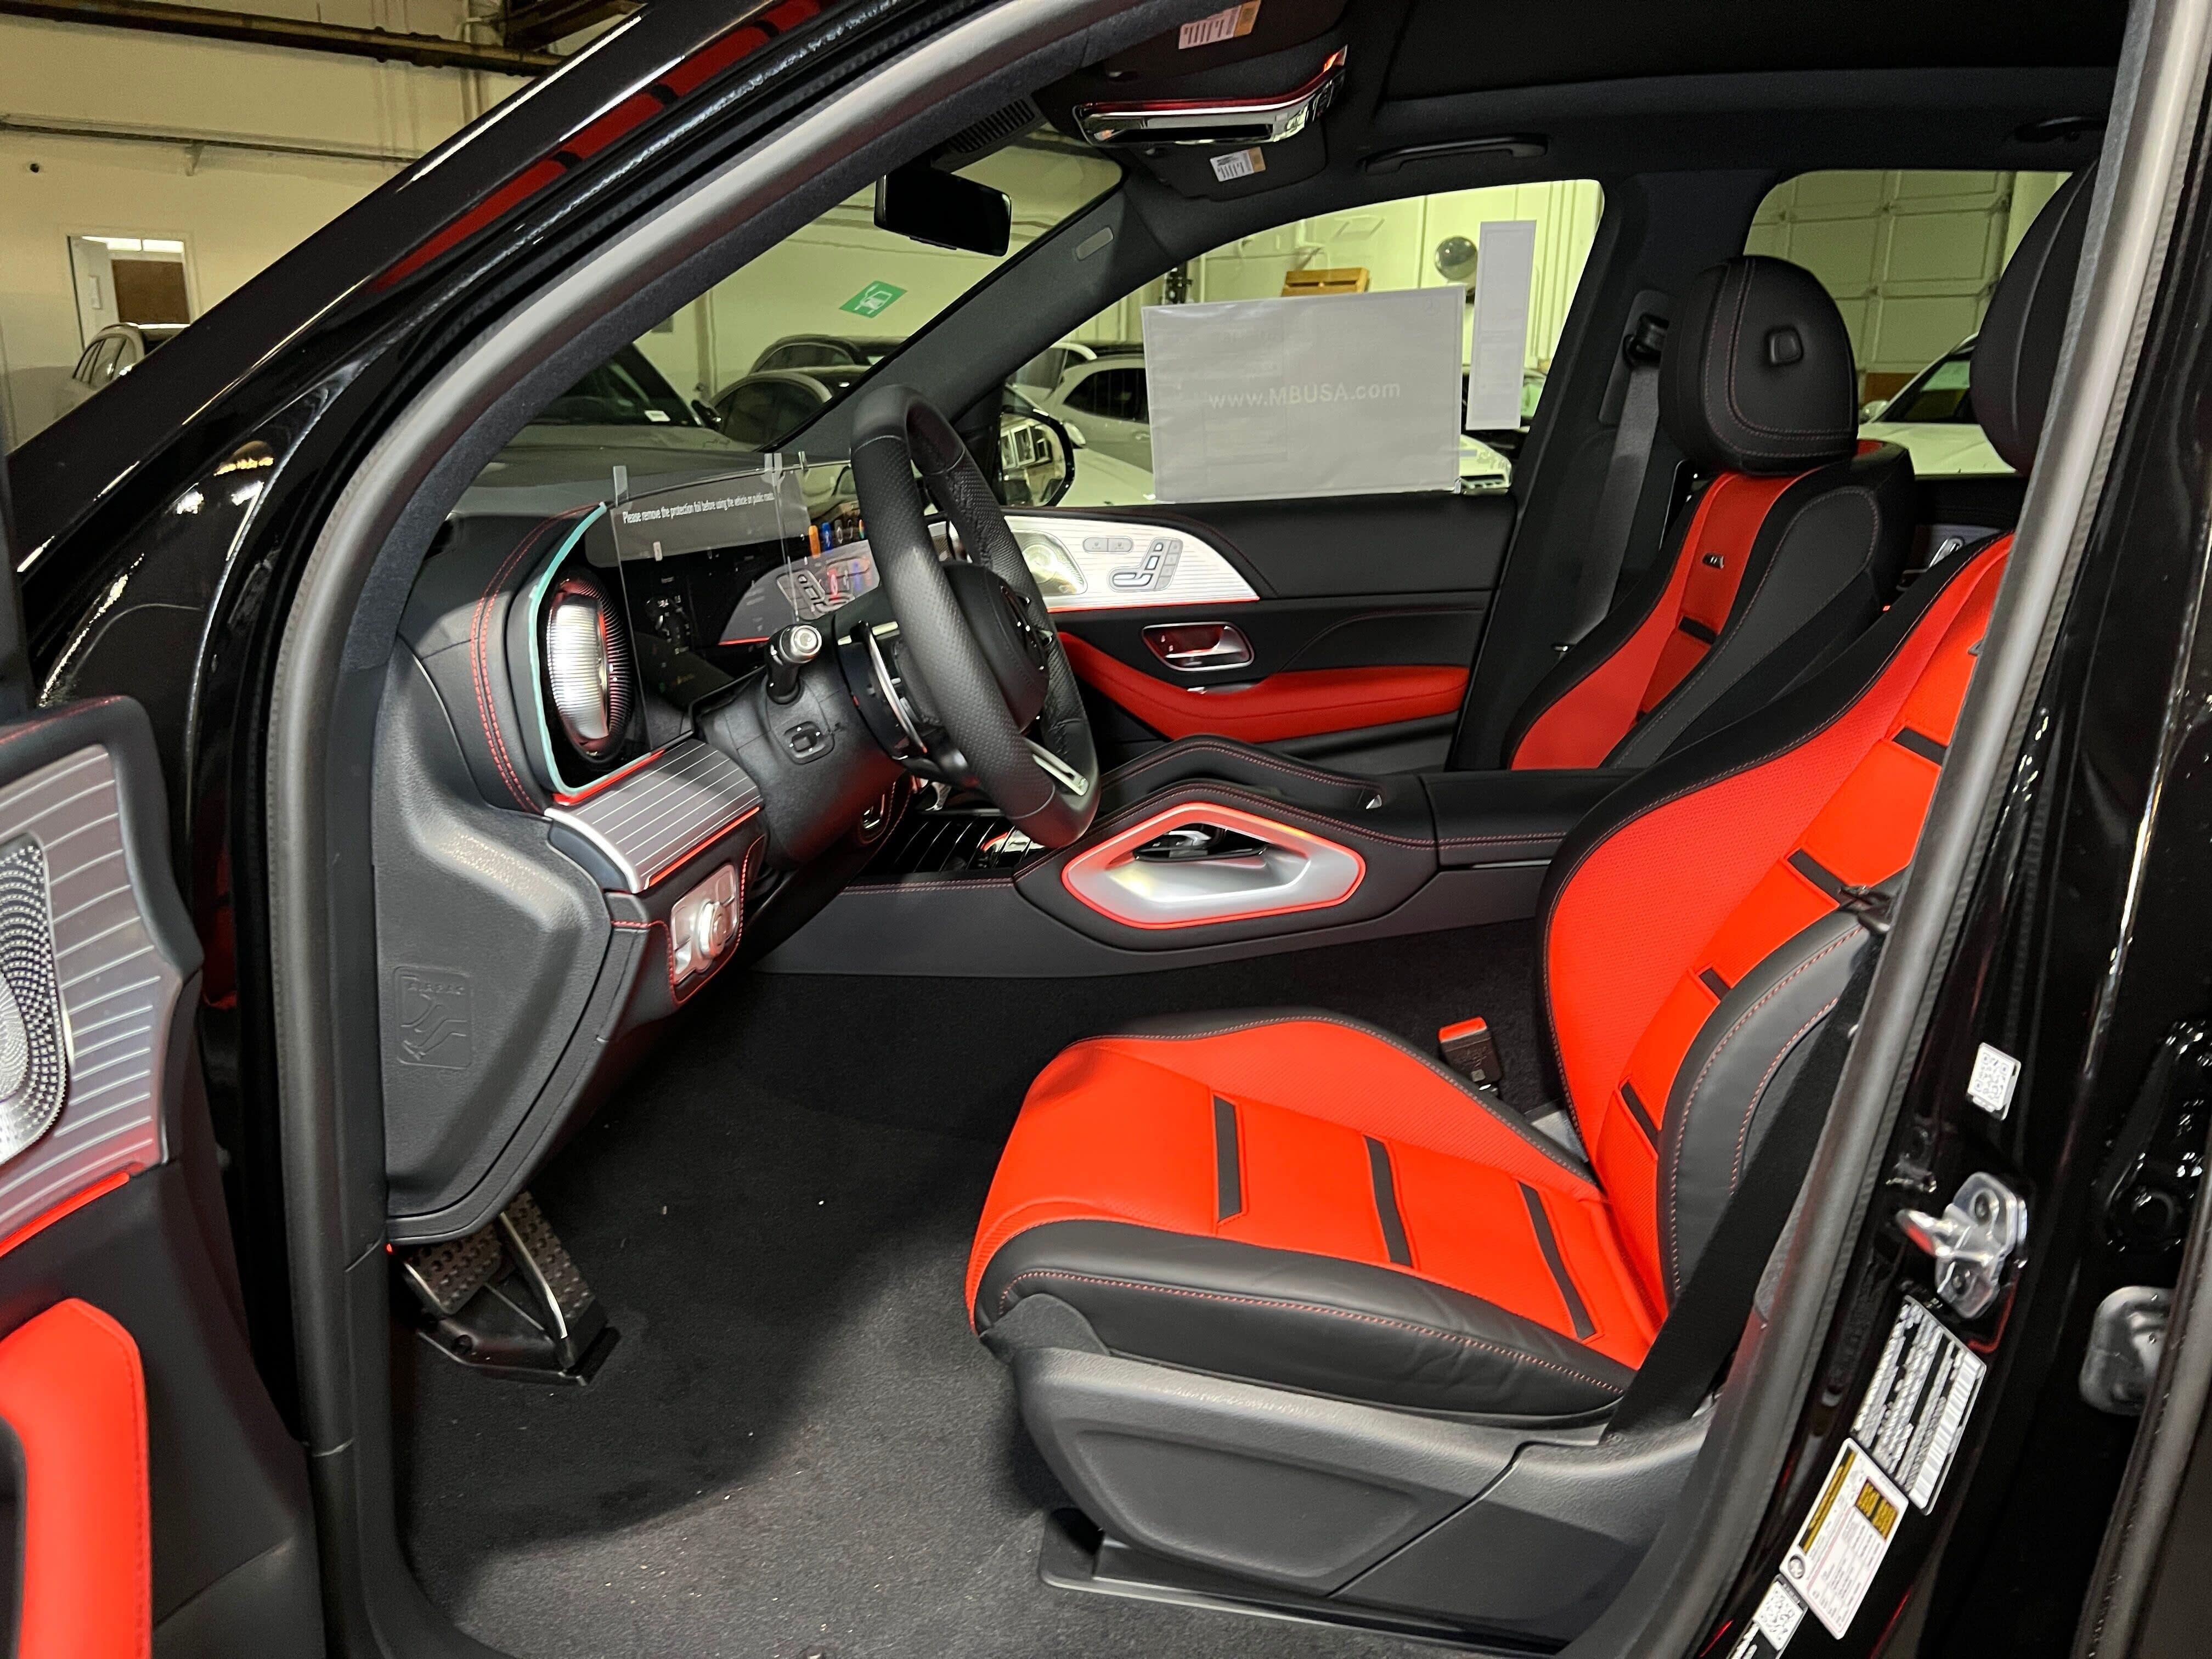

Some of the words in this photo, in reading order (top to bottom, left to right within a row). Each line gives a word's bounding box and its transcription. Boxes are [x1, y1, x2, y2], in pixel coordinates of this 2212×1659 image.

[1208, 381, 1401, 408] www.MBUSA.com
[623, 511, 641, 523] Please
[642, 509, 661, 521] remove
[661, 506, 670, 518] the
